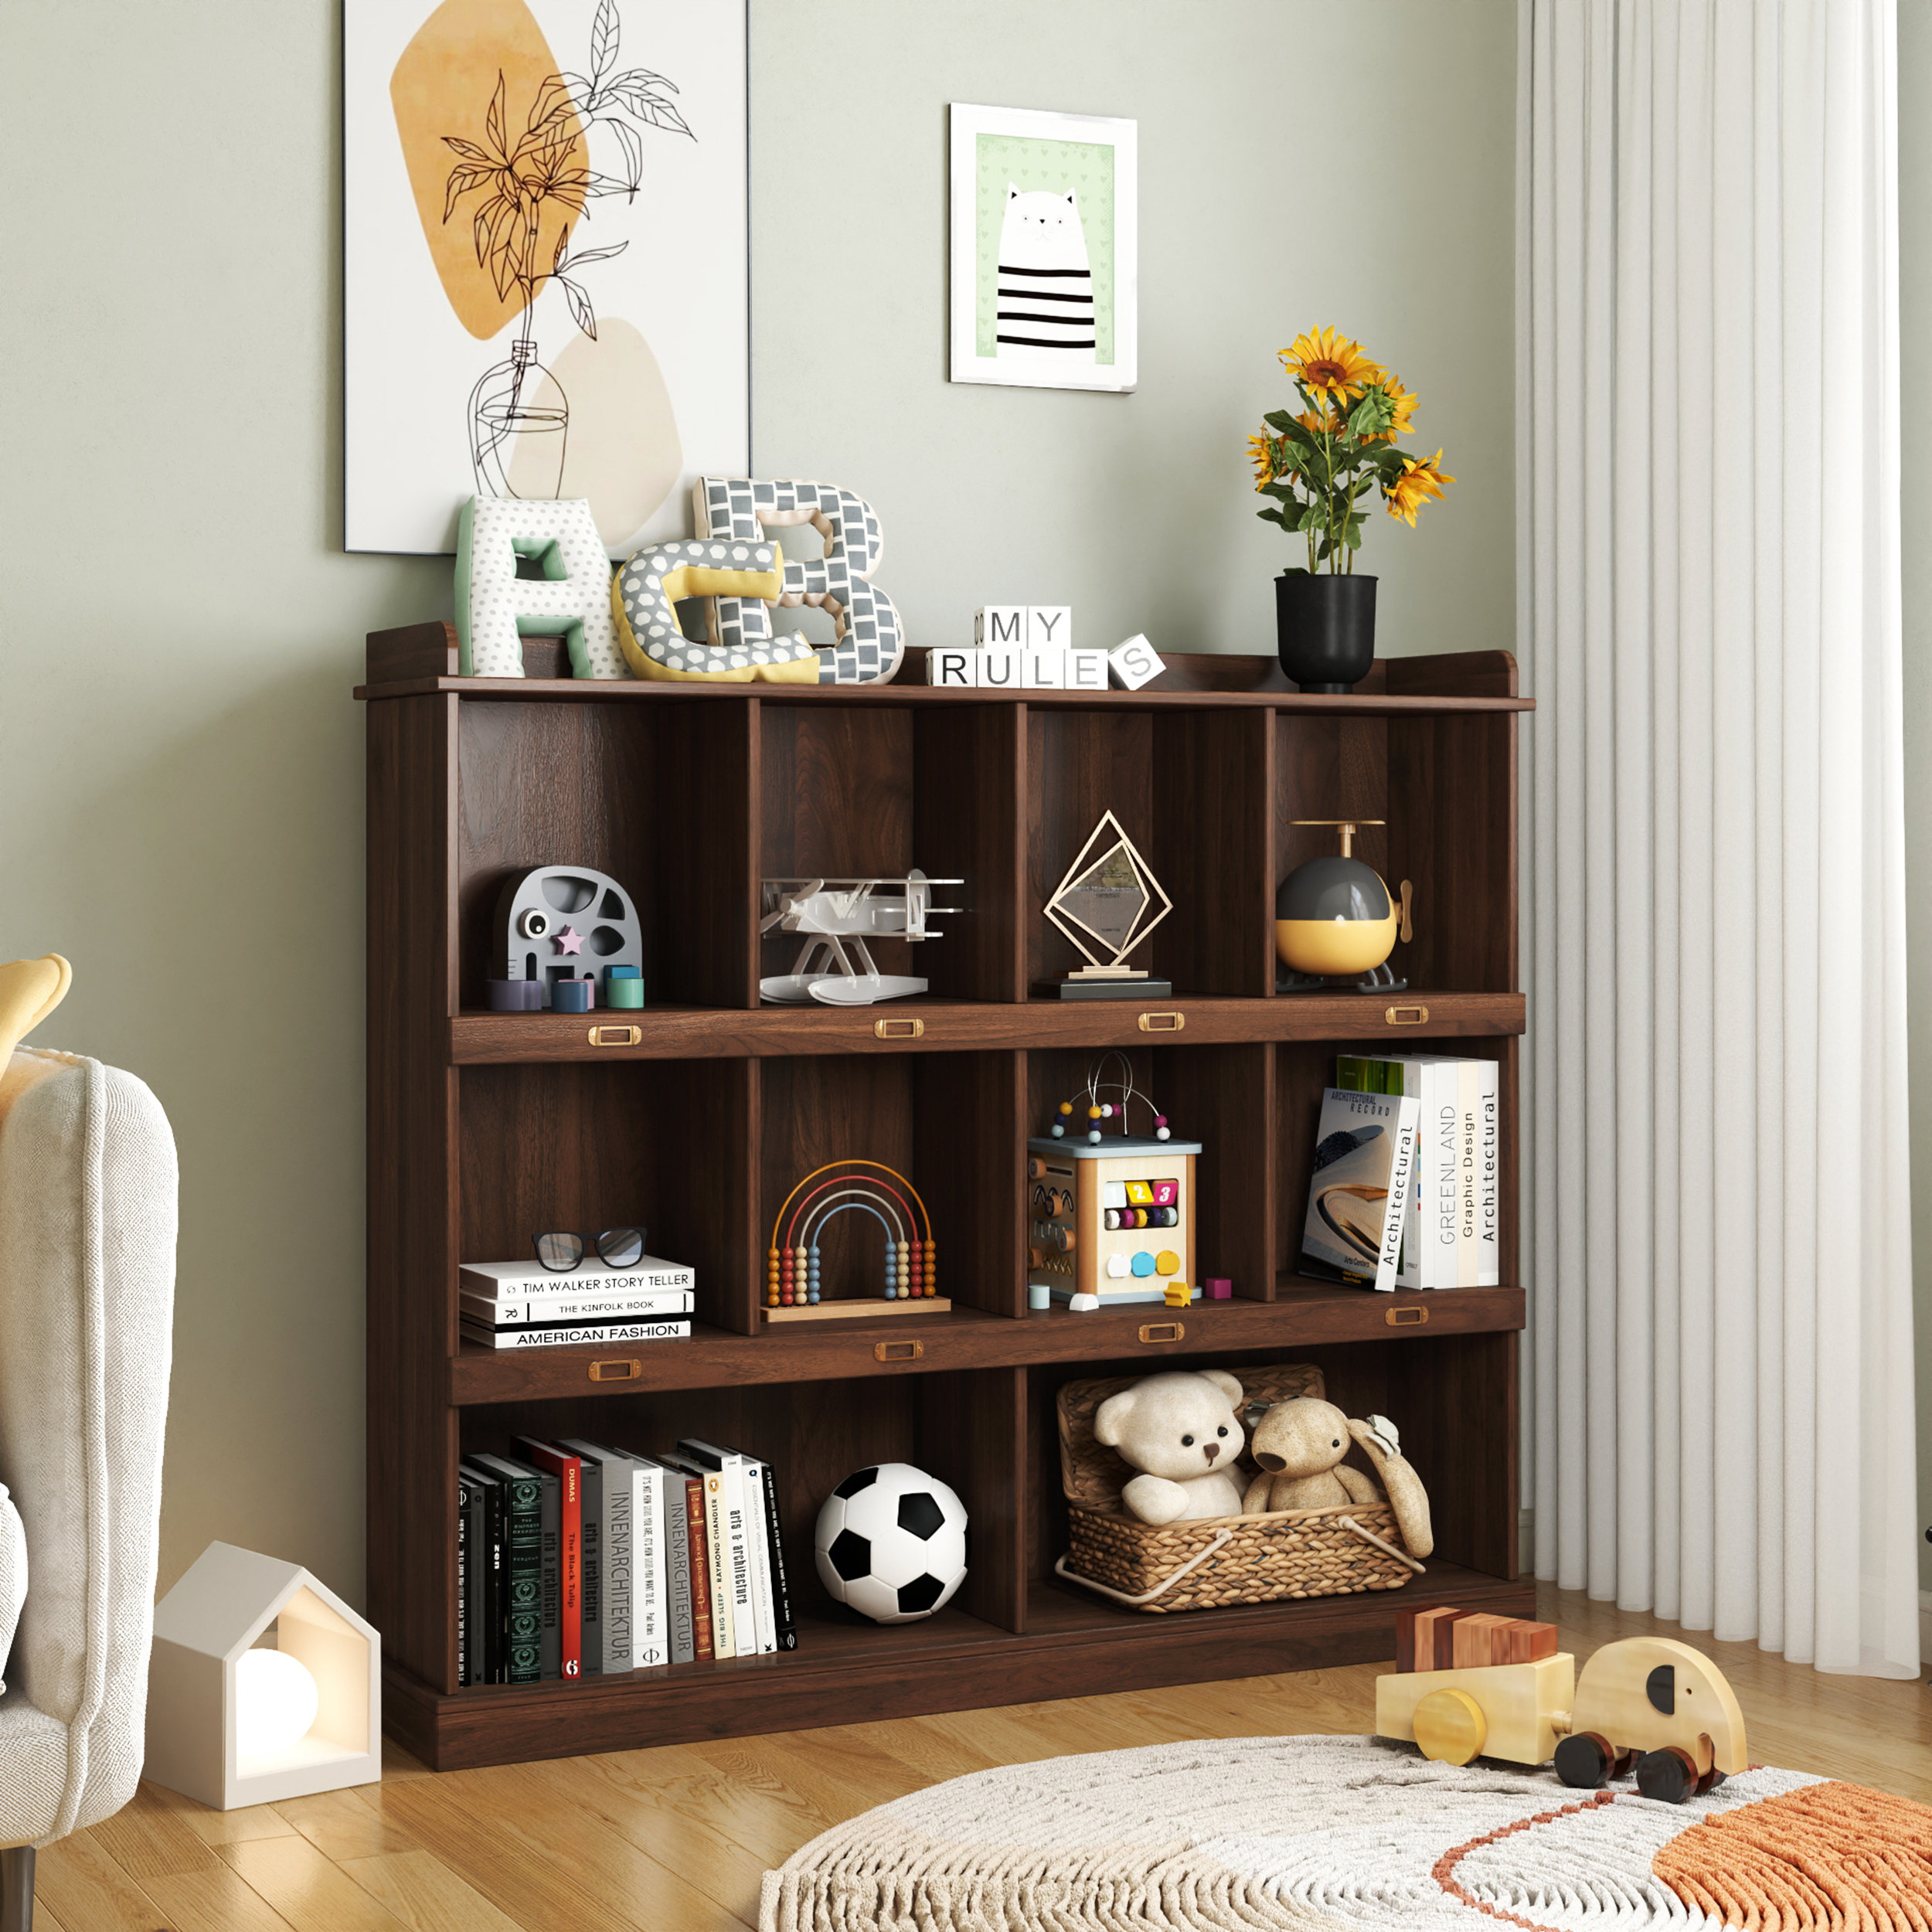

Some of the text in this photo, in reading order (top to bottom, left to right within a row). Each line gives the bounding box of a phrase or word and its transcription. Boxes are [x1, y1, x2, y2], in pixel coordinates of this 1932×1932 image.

[991, 611, 1063, 642] MY
[941, 647, 1151, 685] RULES
[1331, 1090, 1377, 1105] ARCHITECTURAL
[1349, 1103, 1390, 1117] RECORD
[1440, 1105, 1456, 1245] GREENLAND
[1462, 1112, 1475, 1238] Graphic Design
[1481, 1091, 1495, 1242] Architectural
[1133, 1185, 1146, 1199] 2
[1159, 1186, 1171, 1202] 3
[1383, 1125, 1413, 1266] Architectural
[522, 1274, 689, 1294] TIM WALKER STORY TELLER
[559, 1300, 655, 1314] THE KINFOLK BOOK
[516, 1324, 679, 1345] AMERICAN FASHION
[585, 1522, 598, 1543] arts
[730, 1509, 743, 1529] arts
[544, 1532, 557, 1552] arts
[711, 1498, 723, 1583] RAYMOND CHANDLER
[585, 1560, 599, 1623] architecture
[611, 1491, 631, 1660] INNENARCHITEKTUR
[670, 1502, 692, 1652] INNENARCHITEKTUR
[733, 1545, 747, 1605] architecture
[544, 1568, 557, 1628] architecture
[567, 1584, 576, 1608] Tulip
